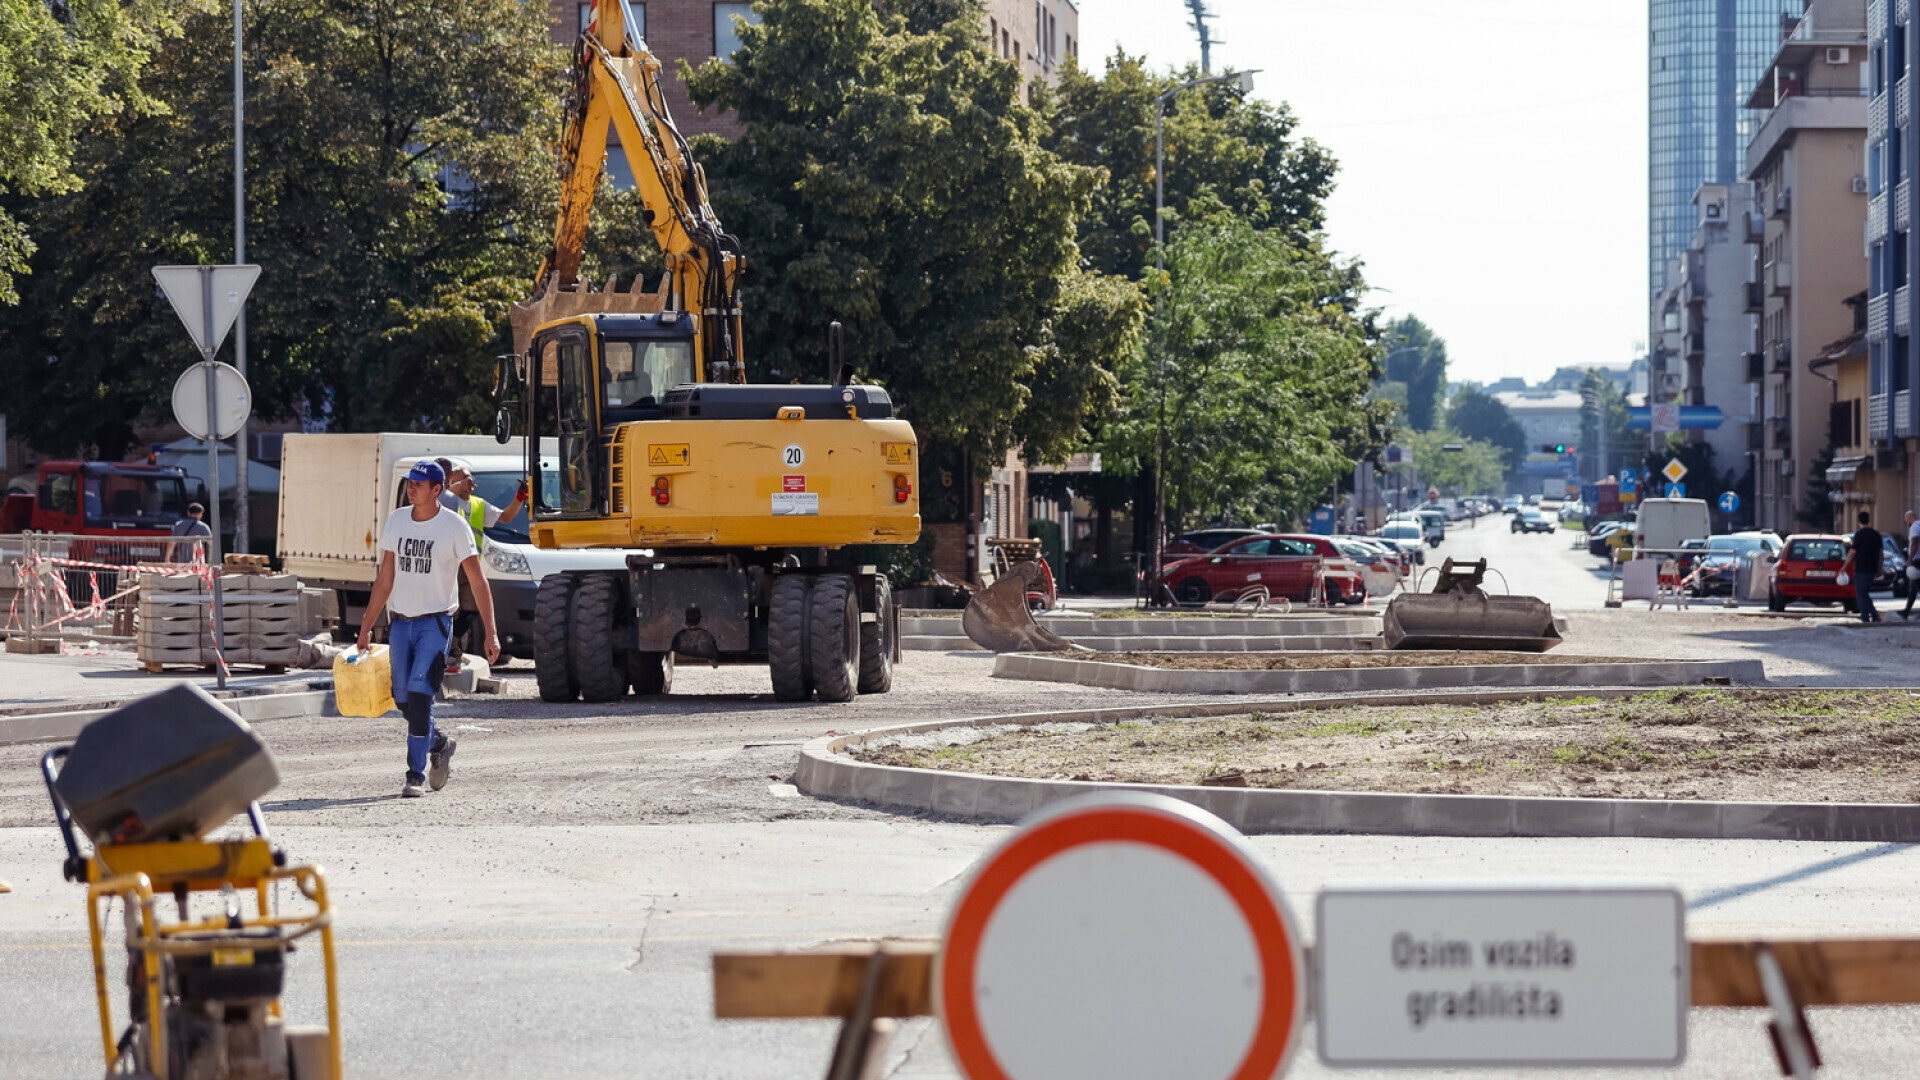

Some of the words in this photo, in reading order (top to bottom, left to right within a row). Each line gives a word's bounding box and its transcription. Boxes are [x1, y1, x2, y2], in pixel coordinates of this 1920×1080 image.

[786, 448, 801, 464] 20
[398, 537, 403, 555] I
[405, 539, 434, 558] COOK
[414, 558, 432, 574] YOU
[1392, 932, 1472, 970] Osim
[1483, 930, 1574, 970] vozila
